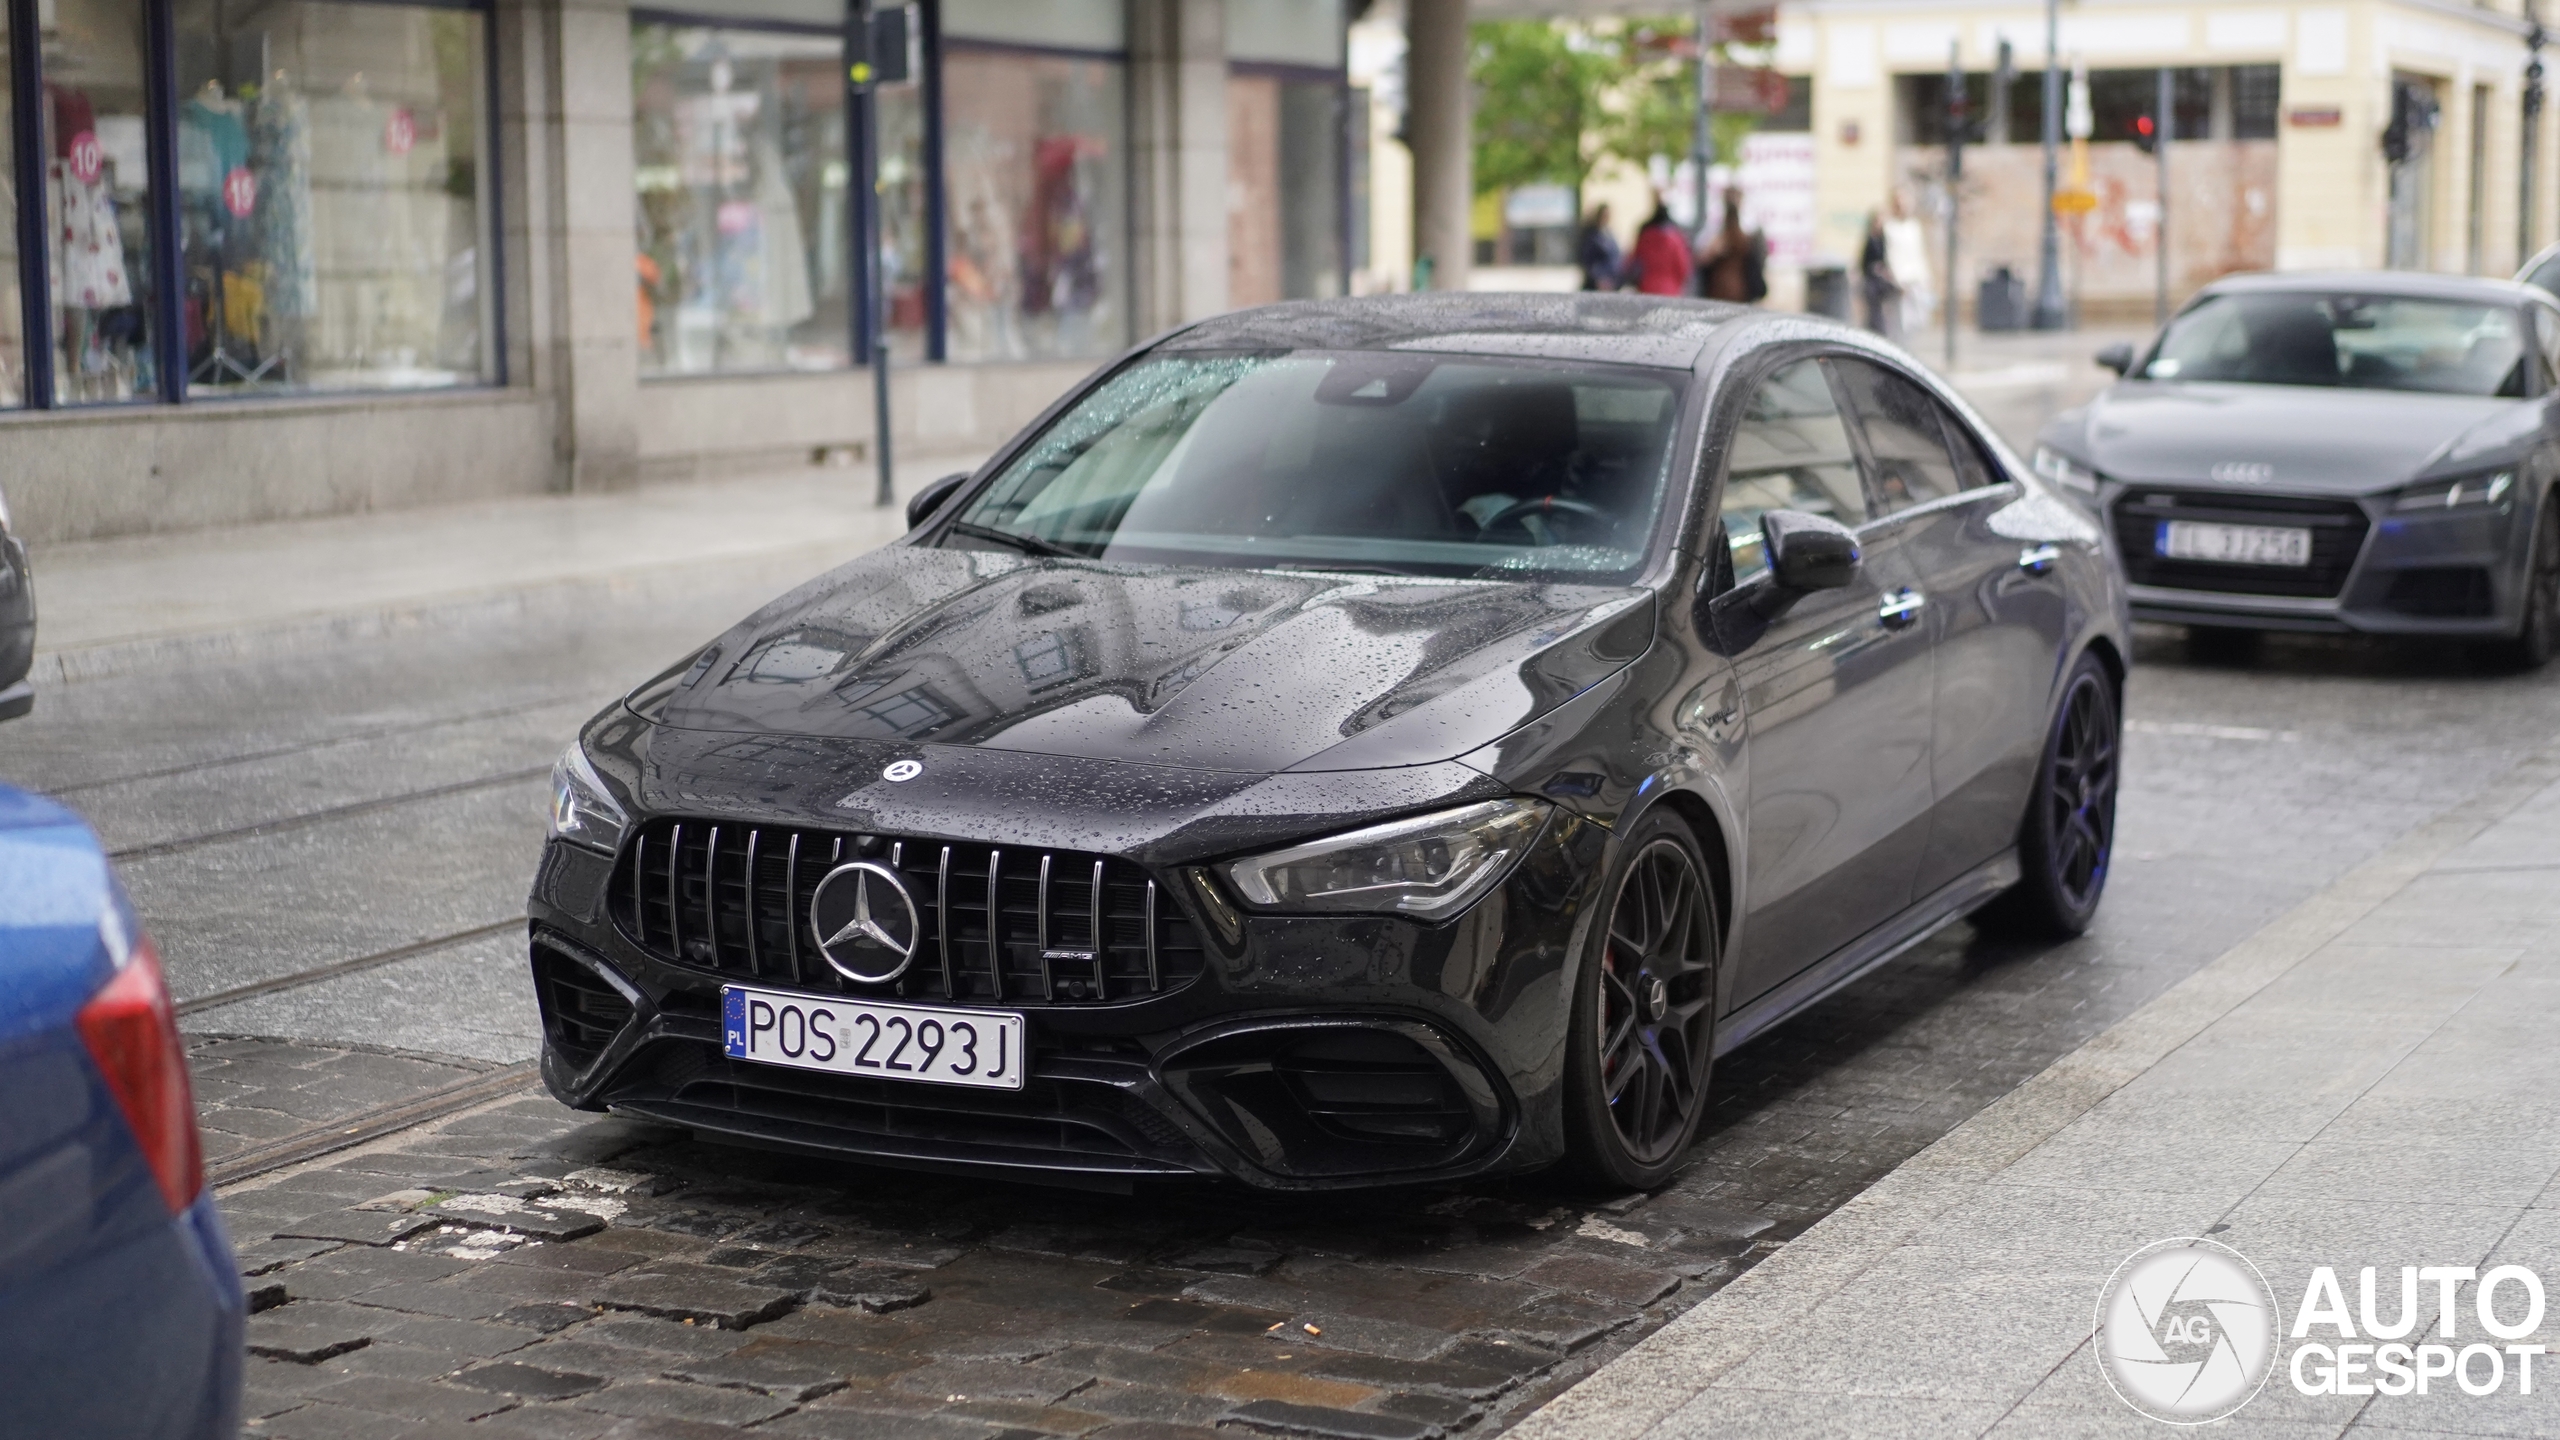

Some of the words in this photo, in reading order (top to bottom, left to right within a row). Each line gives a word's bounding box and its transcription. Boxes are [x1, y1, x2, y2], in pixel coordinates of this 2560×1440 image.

[75, 142, 96, 175] 10
[1059, 951, 1093, 960] AMG
[727, 1029, 744, 1046] PL
[749, 999, 837, 1062] POS
[854, 1012, 1006, 1078] 2293J
